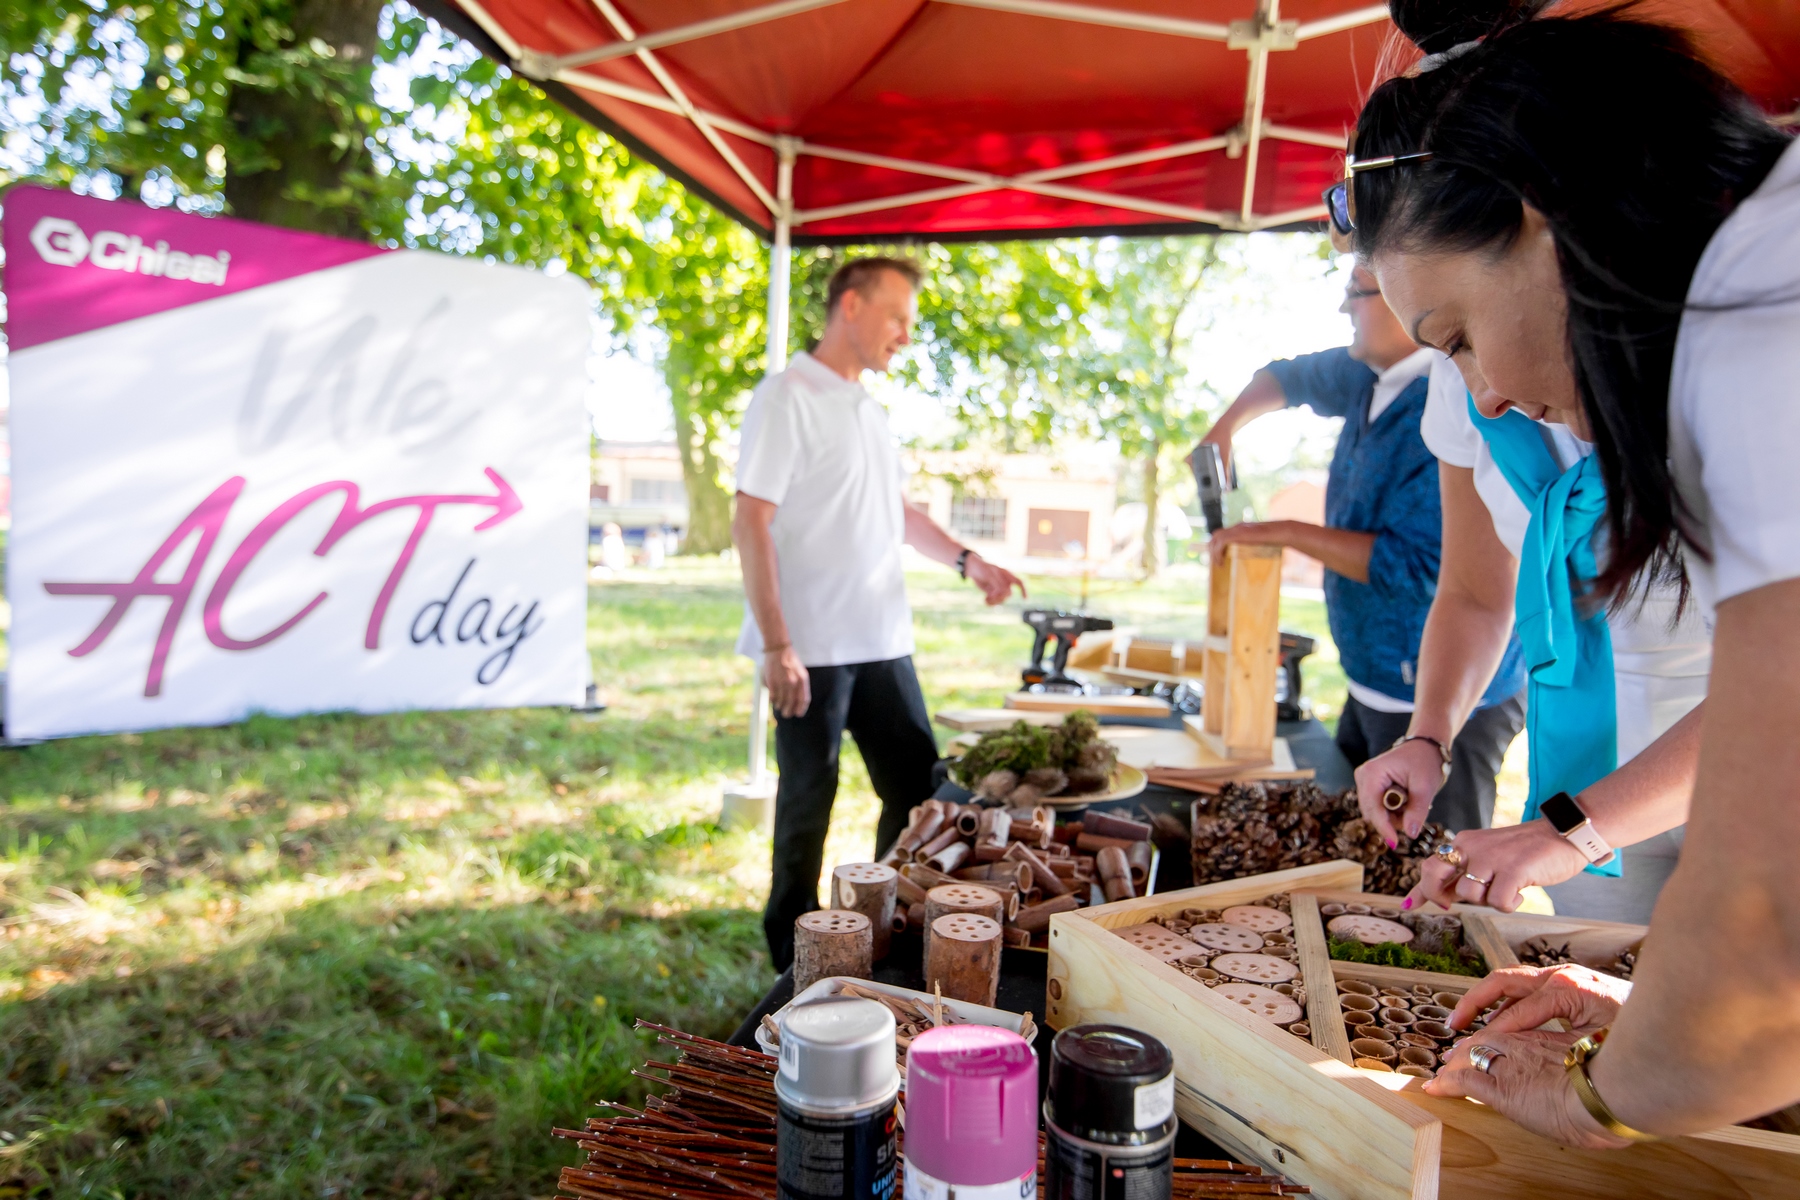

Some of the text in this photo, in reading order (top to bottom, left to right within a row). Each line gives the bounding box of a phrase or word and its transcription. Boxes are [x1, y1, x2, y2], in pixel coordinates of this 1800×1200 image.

[234, 293, 484, 456] We
[43, 466, 524, 698] ACT
[409, 557, 546, 686] day
